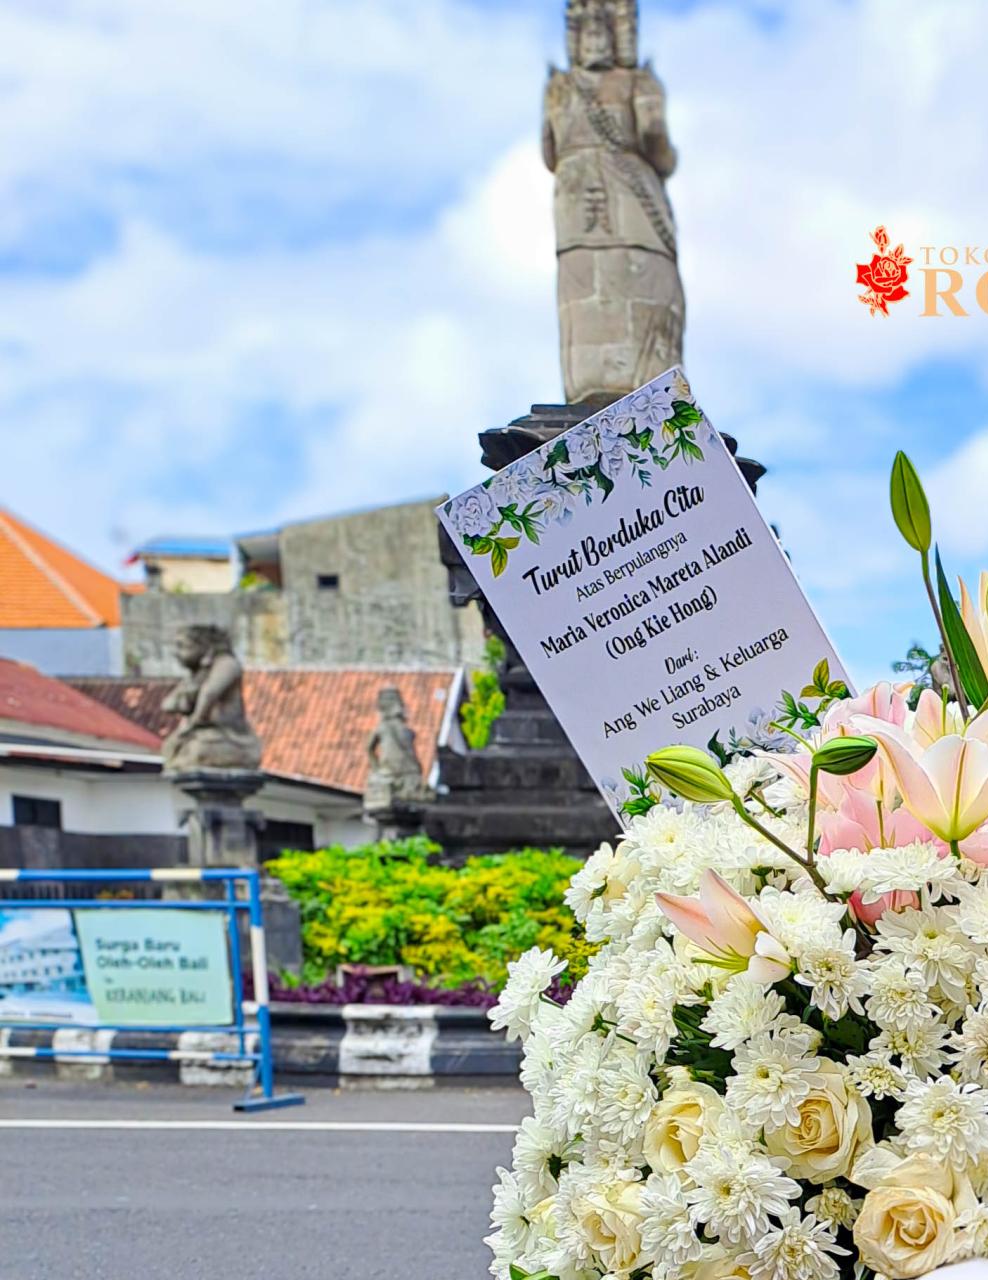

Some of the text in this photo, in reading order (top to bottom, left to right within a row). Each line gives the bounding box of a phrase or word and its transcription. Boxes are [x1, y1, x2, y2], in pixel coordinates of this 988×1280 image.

[522, 485, 705, 595] Turut Berduka Cita
[576, 532, 688, 602] Atas Berpulangnya
[540, 527, 753, 659] Maria Veronica Mareta Alandi
[606, 585, 718, 660] (Ong Kie Hong)
[603, 628, 790, 739] Ang We Liang & Keluarga
[672, 686, 742, 729] Surabaya
[179, 956, 209, 970] Bali
